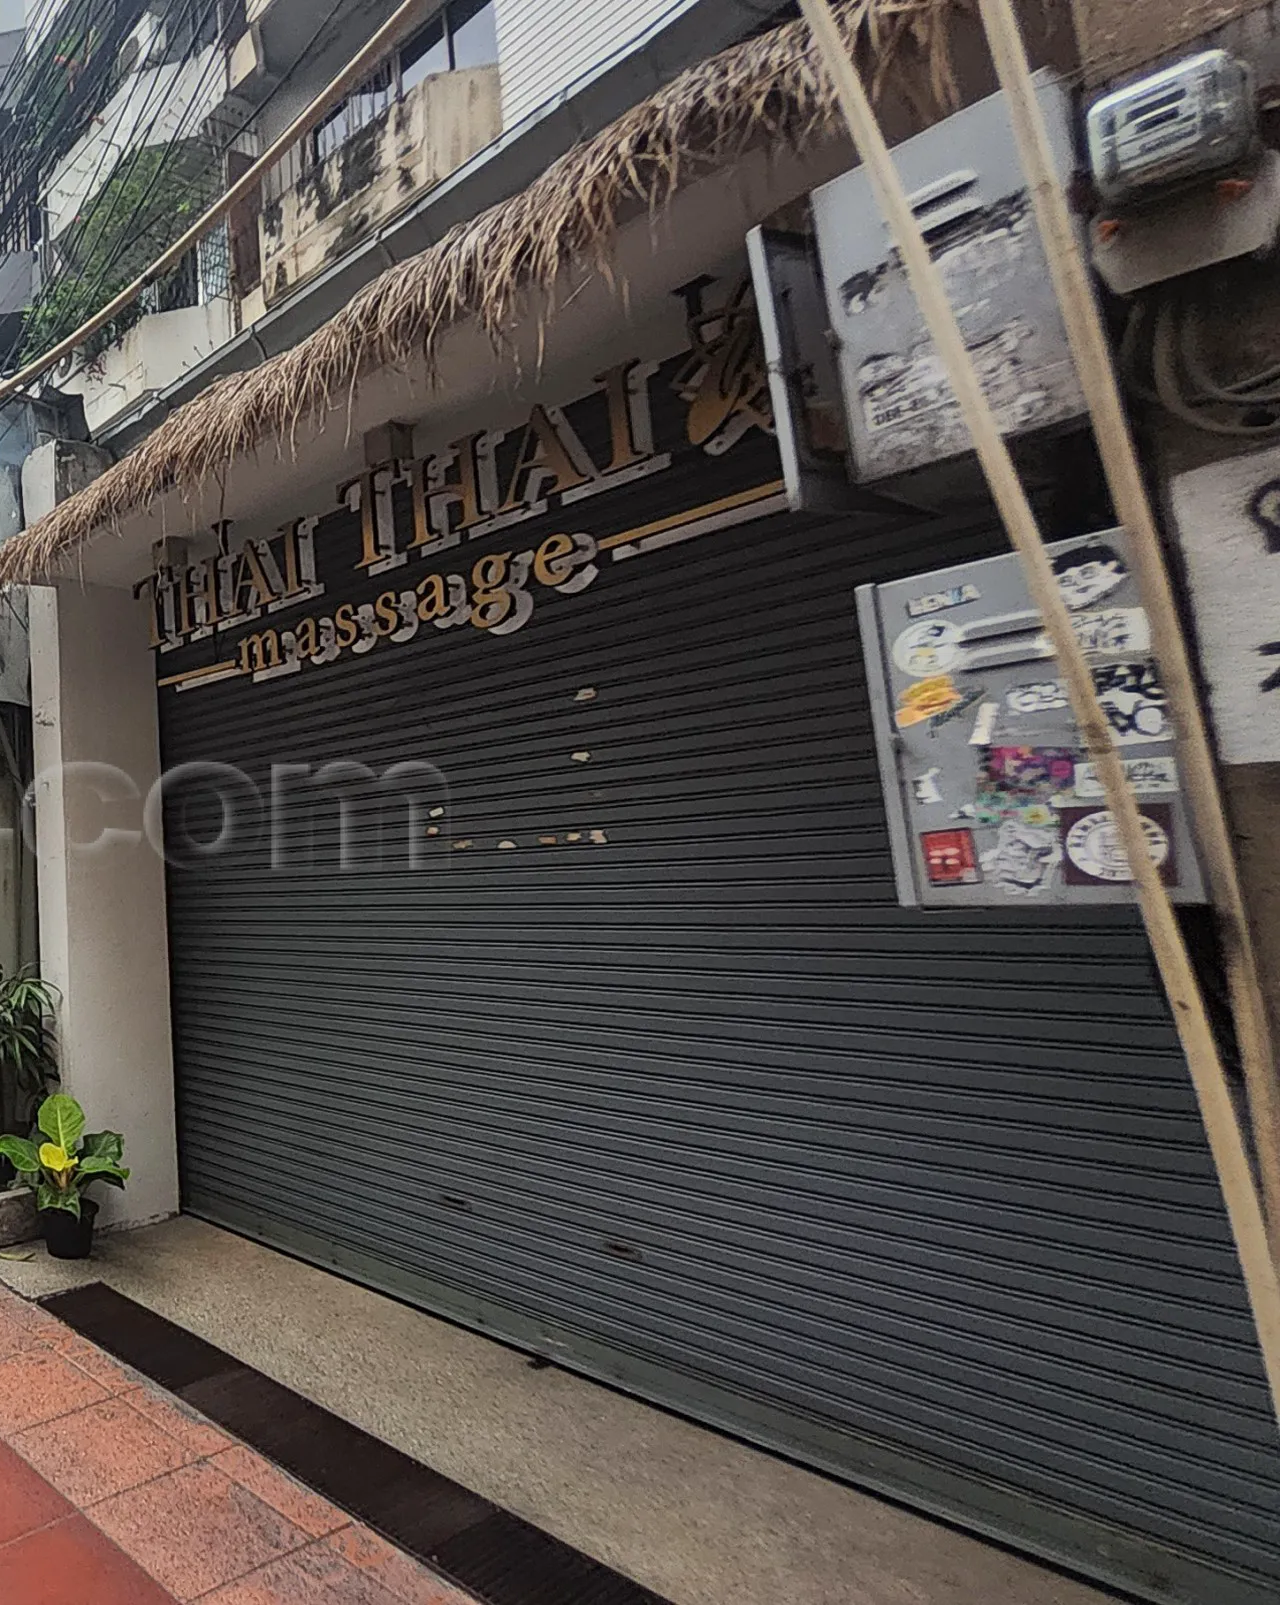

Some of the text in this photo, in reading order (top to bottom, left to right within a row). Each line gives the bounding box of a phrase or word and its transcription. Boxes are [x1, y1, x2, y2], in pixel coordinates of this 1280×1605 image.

[131, 357, 658, 650] THAI THAI
[238, 533, 580, 676] massage
